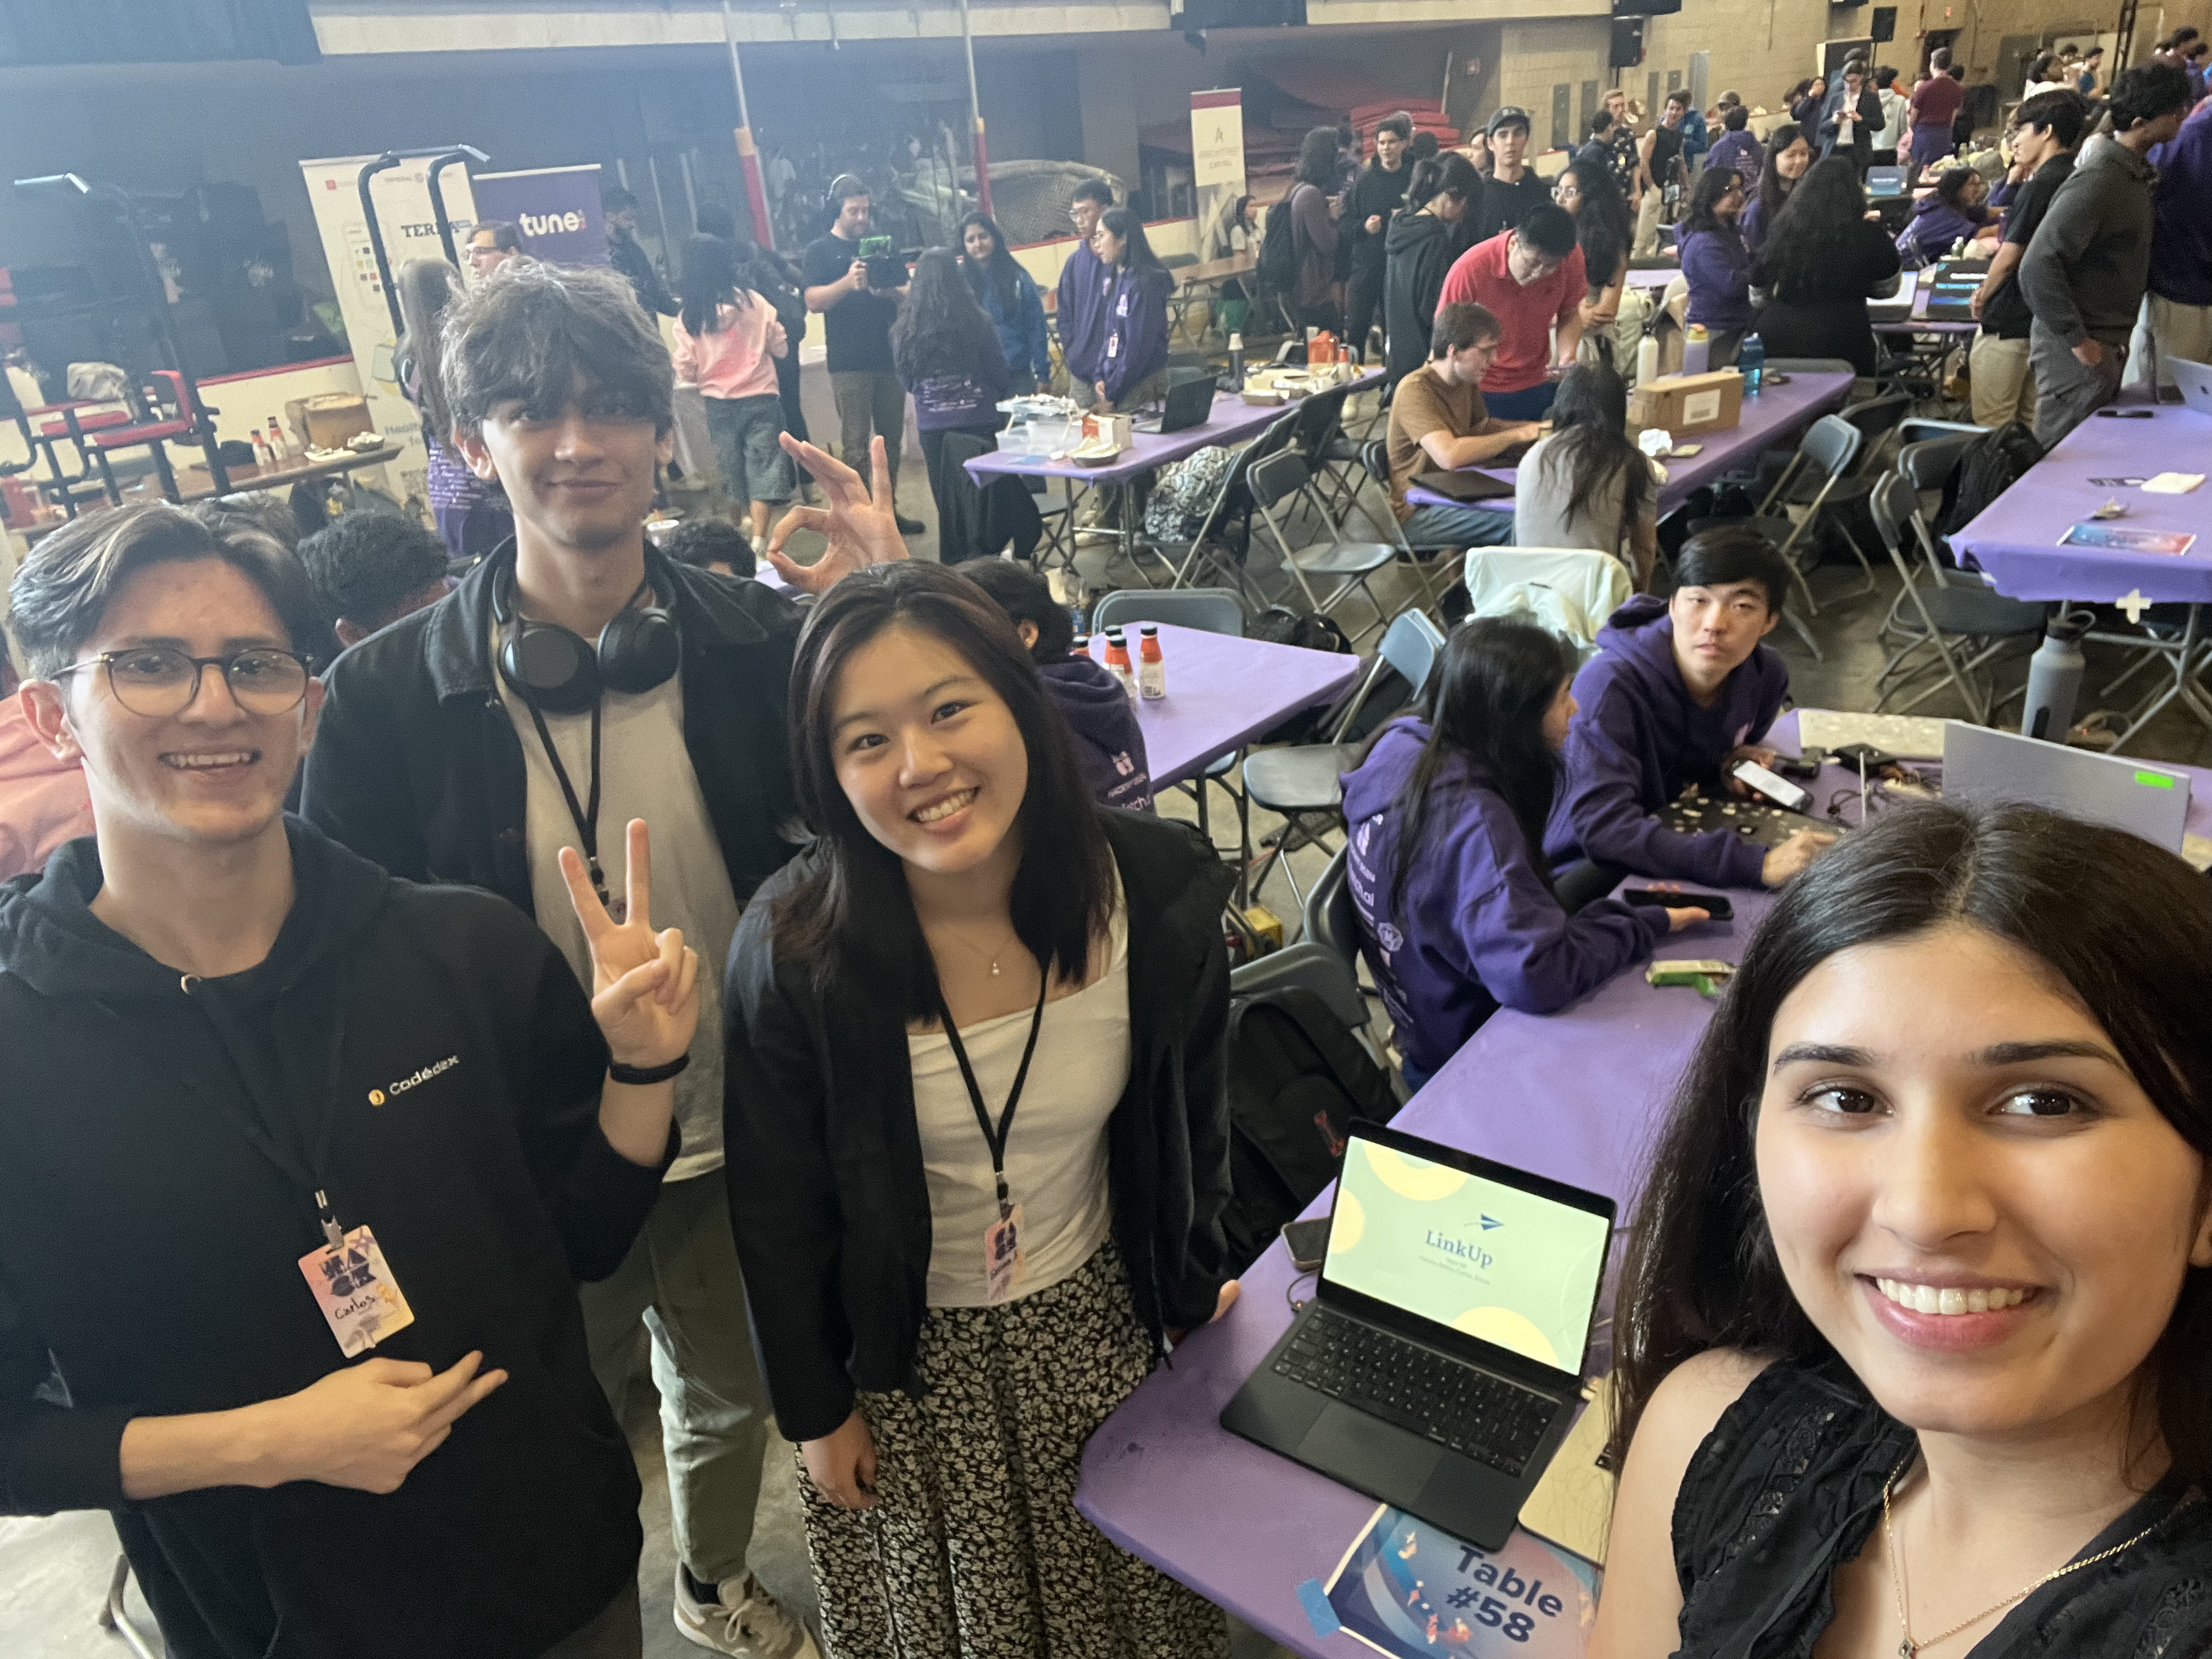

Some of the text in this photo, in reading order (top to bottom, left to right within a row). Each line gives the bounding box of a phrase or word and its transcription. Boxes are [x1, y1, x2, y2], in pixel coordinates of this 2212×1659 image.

[1425, 1229, 1493, 1269] LinkUp
[1457, 1544, 1563, 1618] Table
[1446, 1587, 1536, 1643] #58
